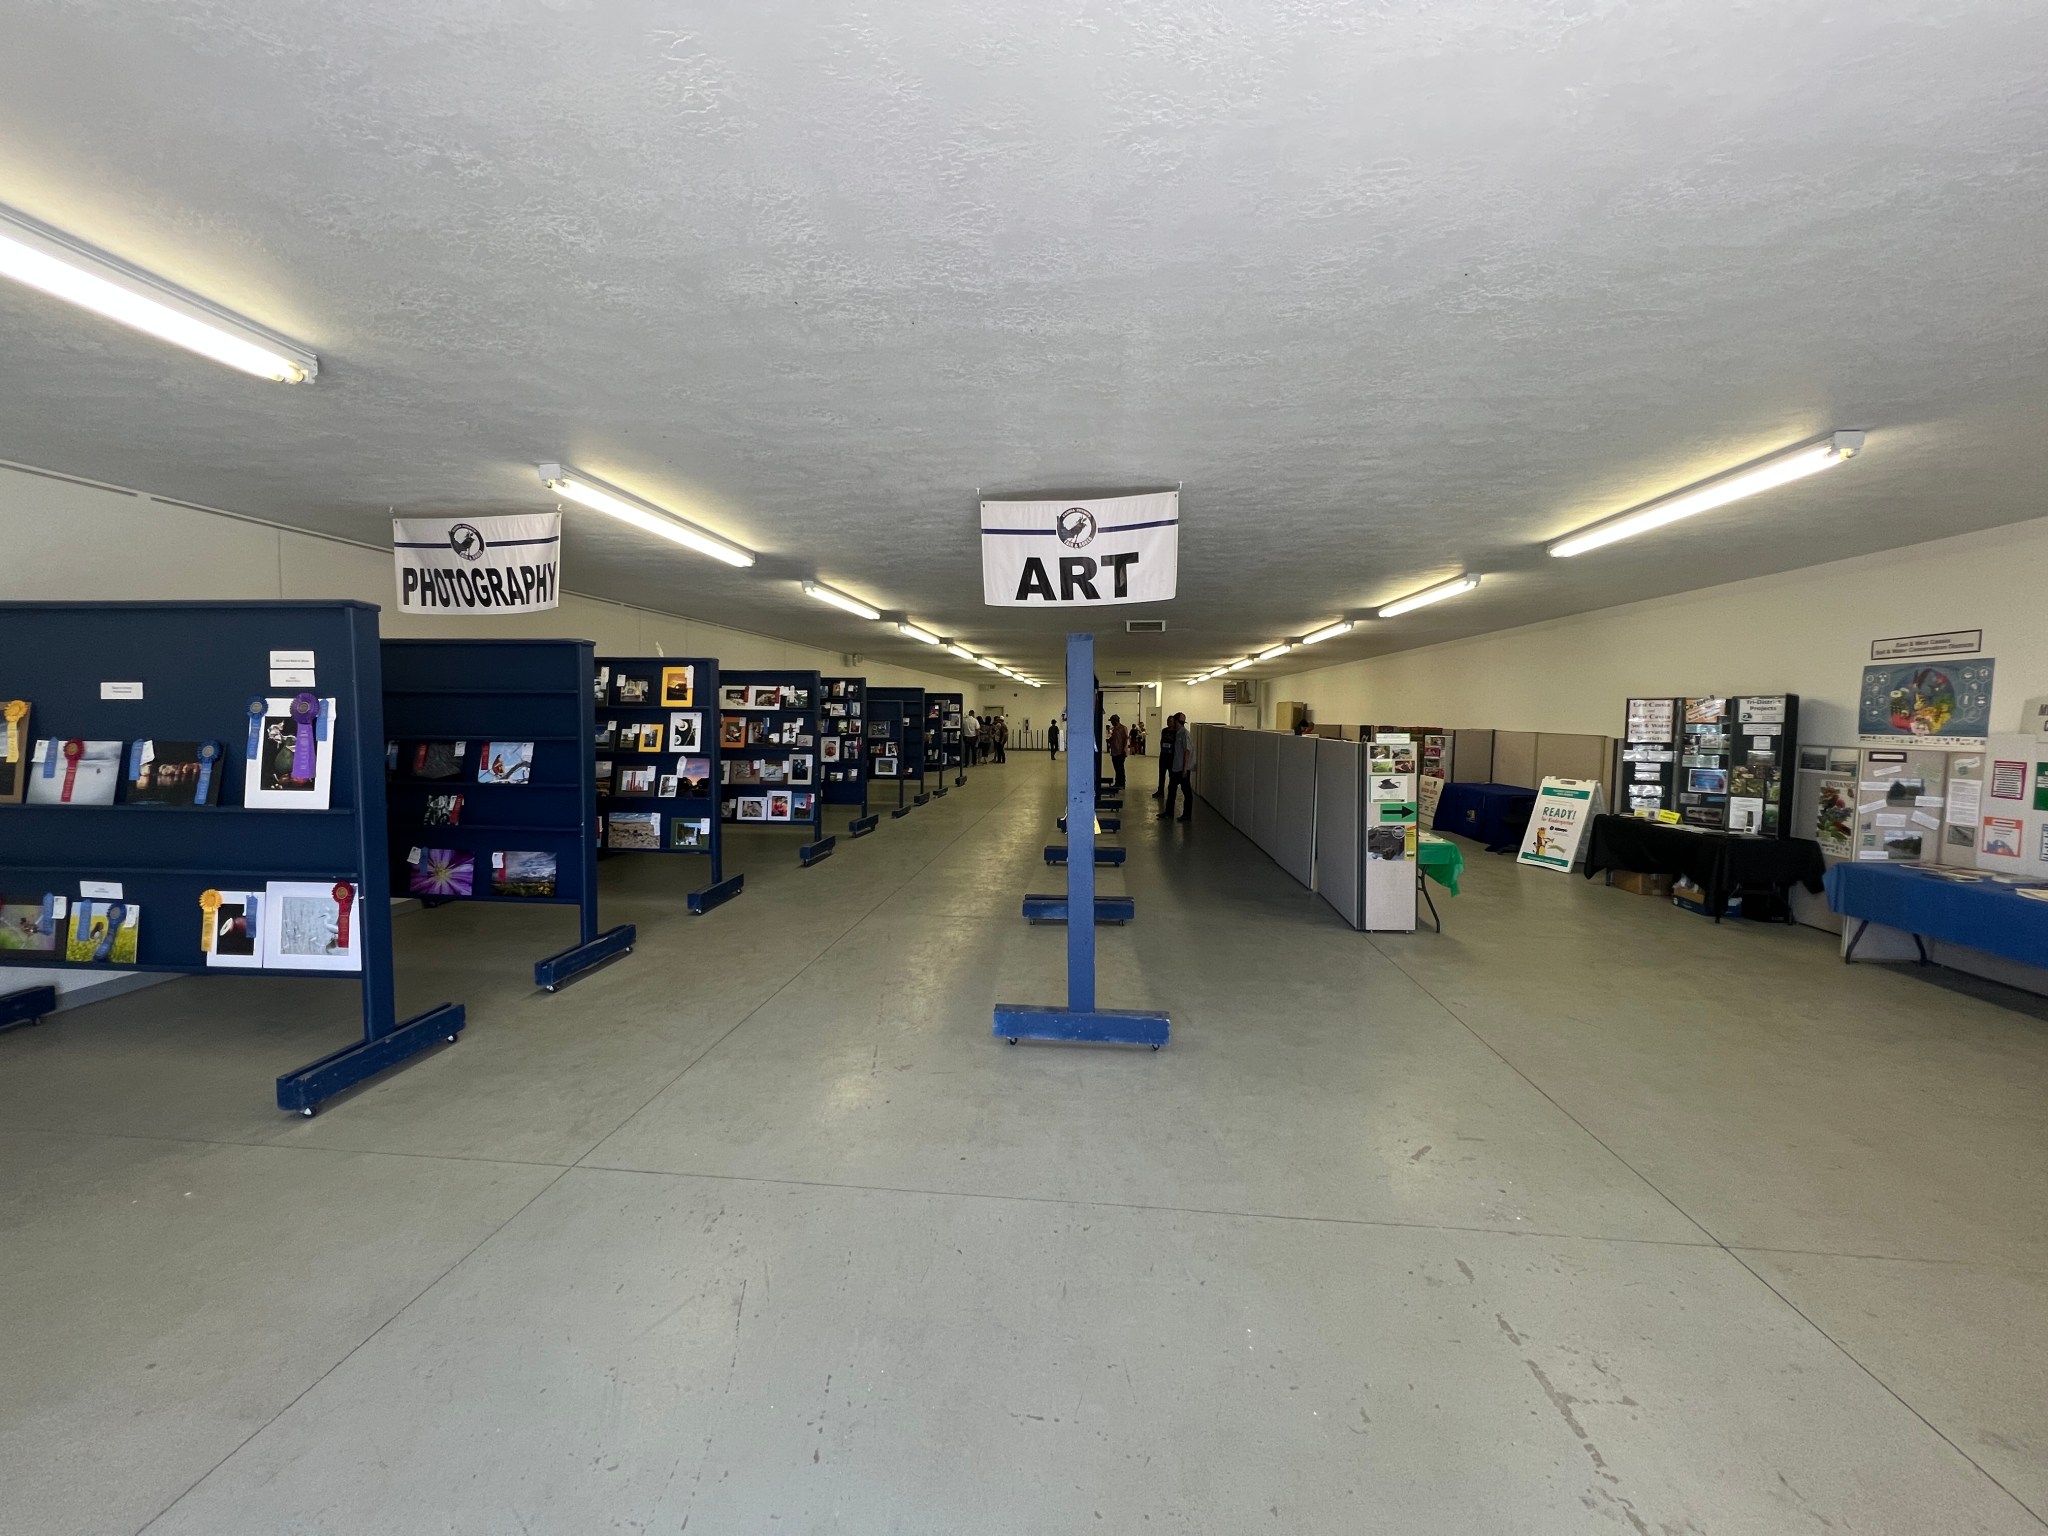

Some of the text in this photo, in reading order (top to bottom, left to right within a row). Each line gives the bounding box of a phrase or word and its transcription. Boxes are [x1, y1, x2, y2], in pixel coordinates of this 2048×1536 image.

[402, 561, 557, 608] PHOTOGRAPHY
[1015, 551, 1140, 601] ART
[1542, 806, 1576, 820] READY!
